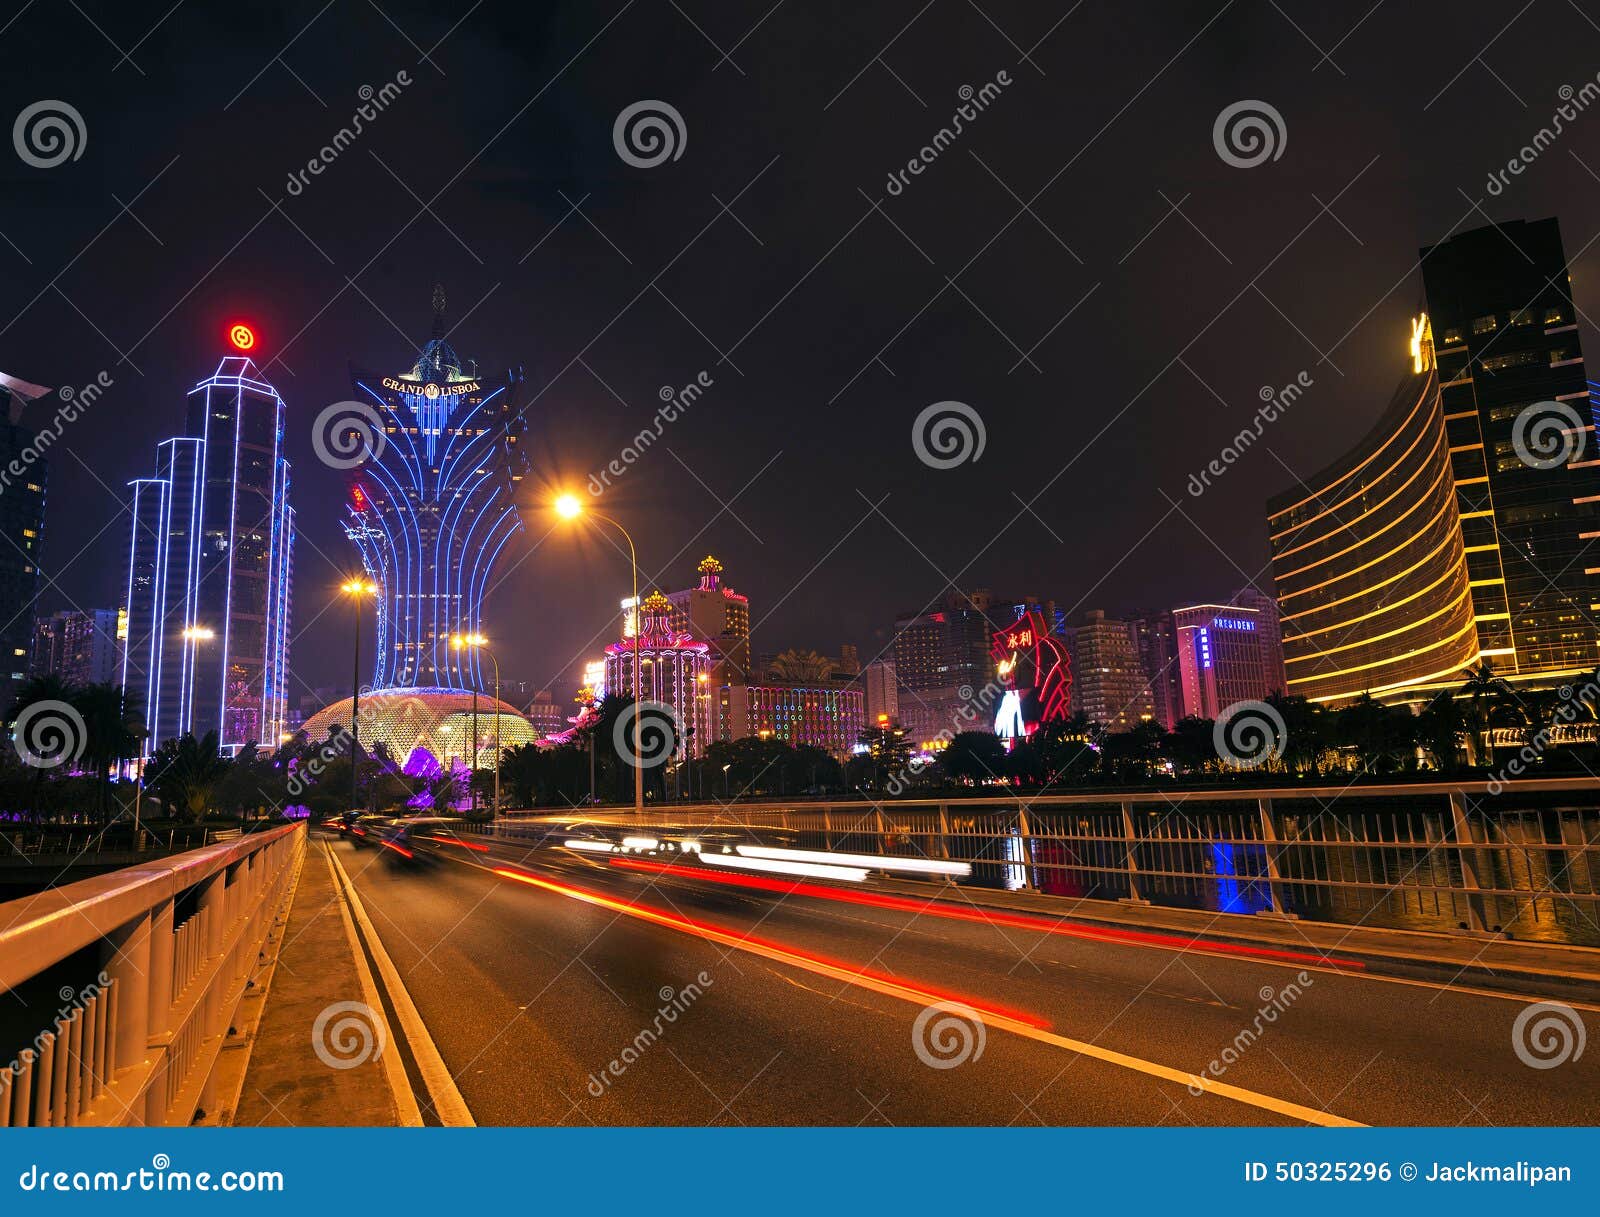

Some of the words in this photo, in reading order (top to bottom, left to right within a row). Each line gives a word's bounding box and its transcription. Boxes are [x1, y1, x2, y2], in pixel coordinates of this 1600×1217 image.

[382, 377, 424, 396] GRAND
[440, 381, 480, 397] LISBOA
[1214, 618, 1255, 630] PRESIDENT
[1007, 629, 1032, 649] 永利
